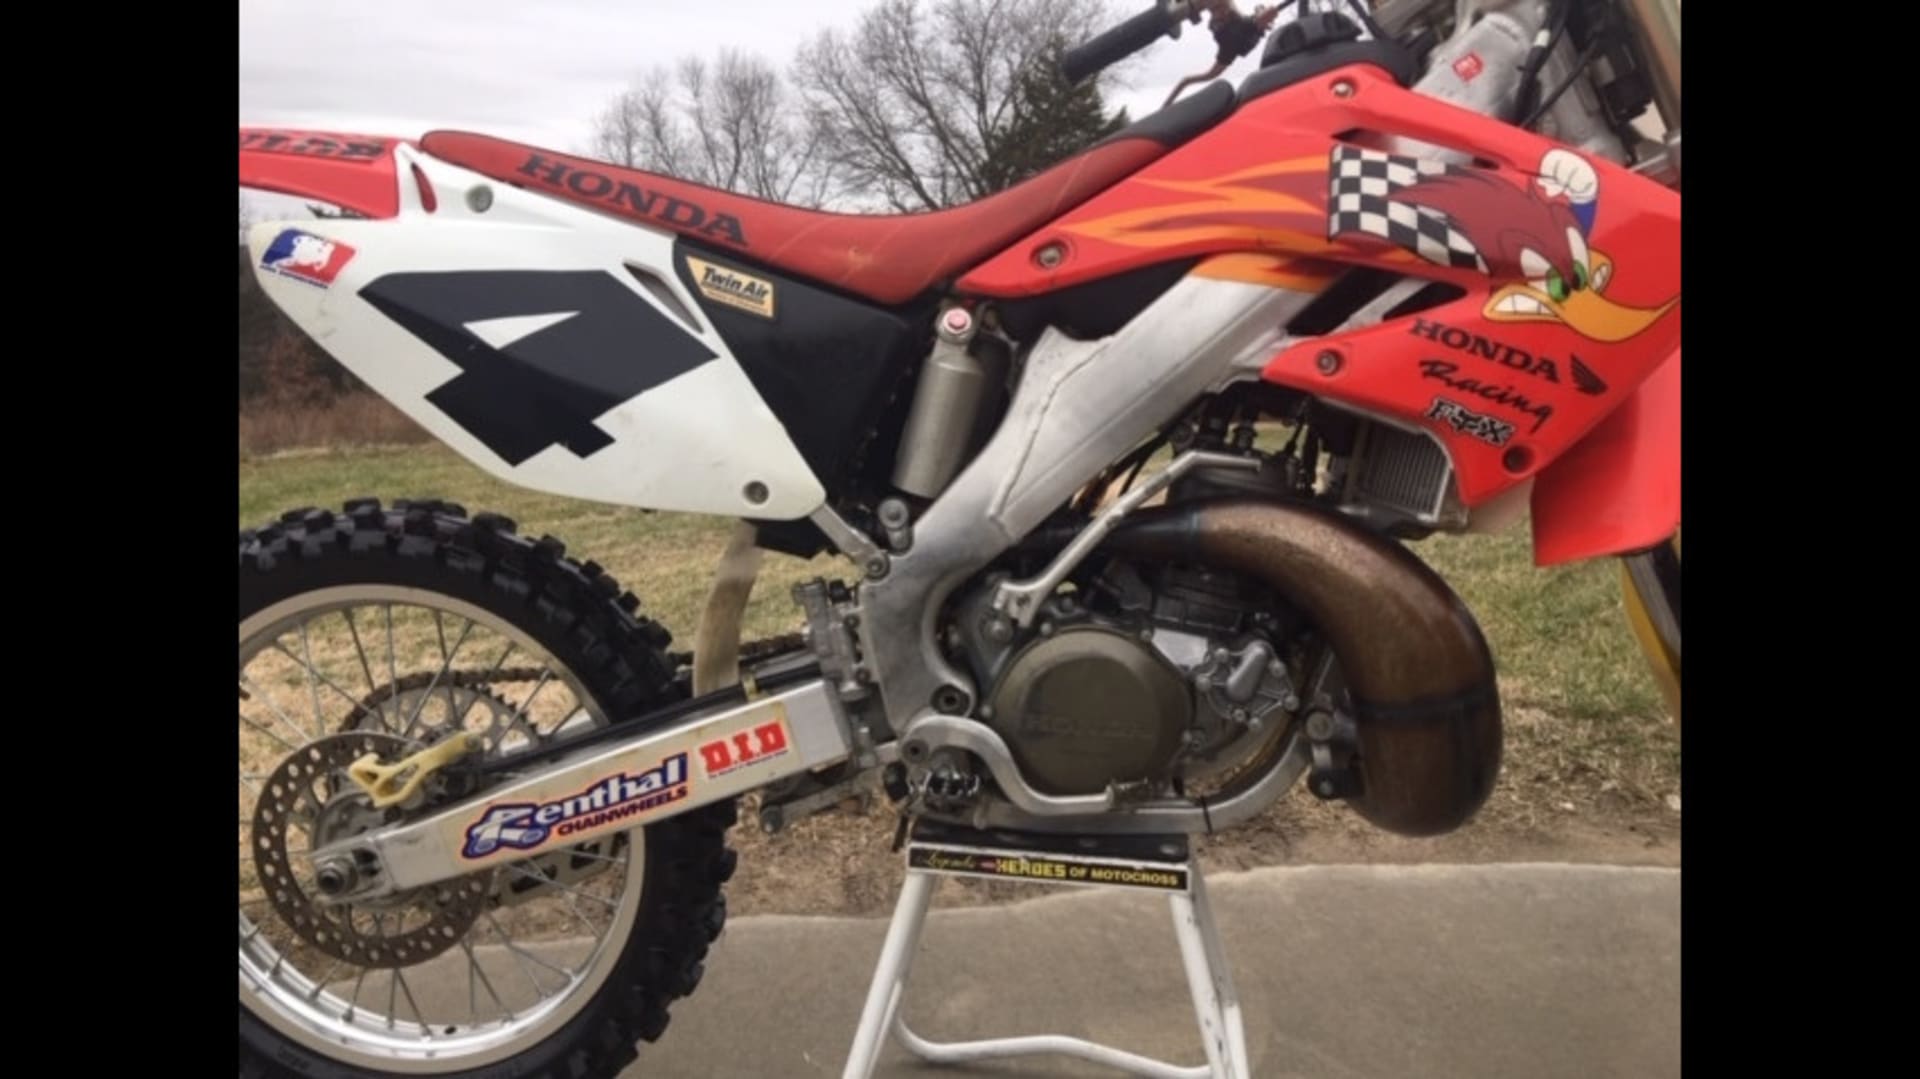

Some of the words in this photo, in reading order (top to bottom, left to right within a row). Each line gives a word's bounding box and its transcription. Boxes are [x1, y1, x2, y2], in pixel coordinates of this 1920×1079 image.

[516, 154, 749, 248] HONDA
[702, 266, 743, 291] Twin
[744, 280, 769, 298] Air
[357, 269, 720, 467] 4
[1409, 318, 1562, 383] HONDA
[1418, 359, 1554, 434] Racing
[462, 751, 690, 860] Renthal
[556, 786, 690, 837] CHAINWHEELS
[997, 857, 1067, 878] HEROES
[1069, 867, 1088, 878] OF
[1091, 869, 1178, 886] MOTOCROSS
